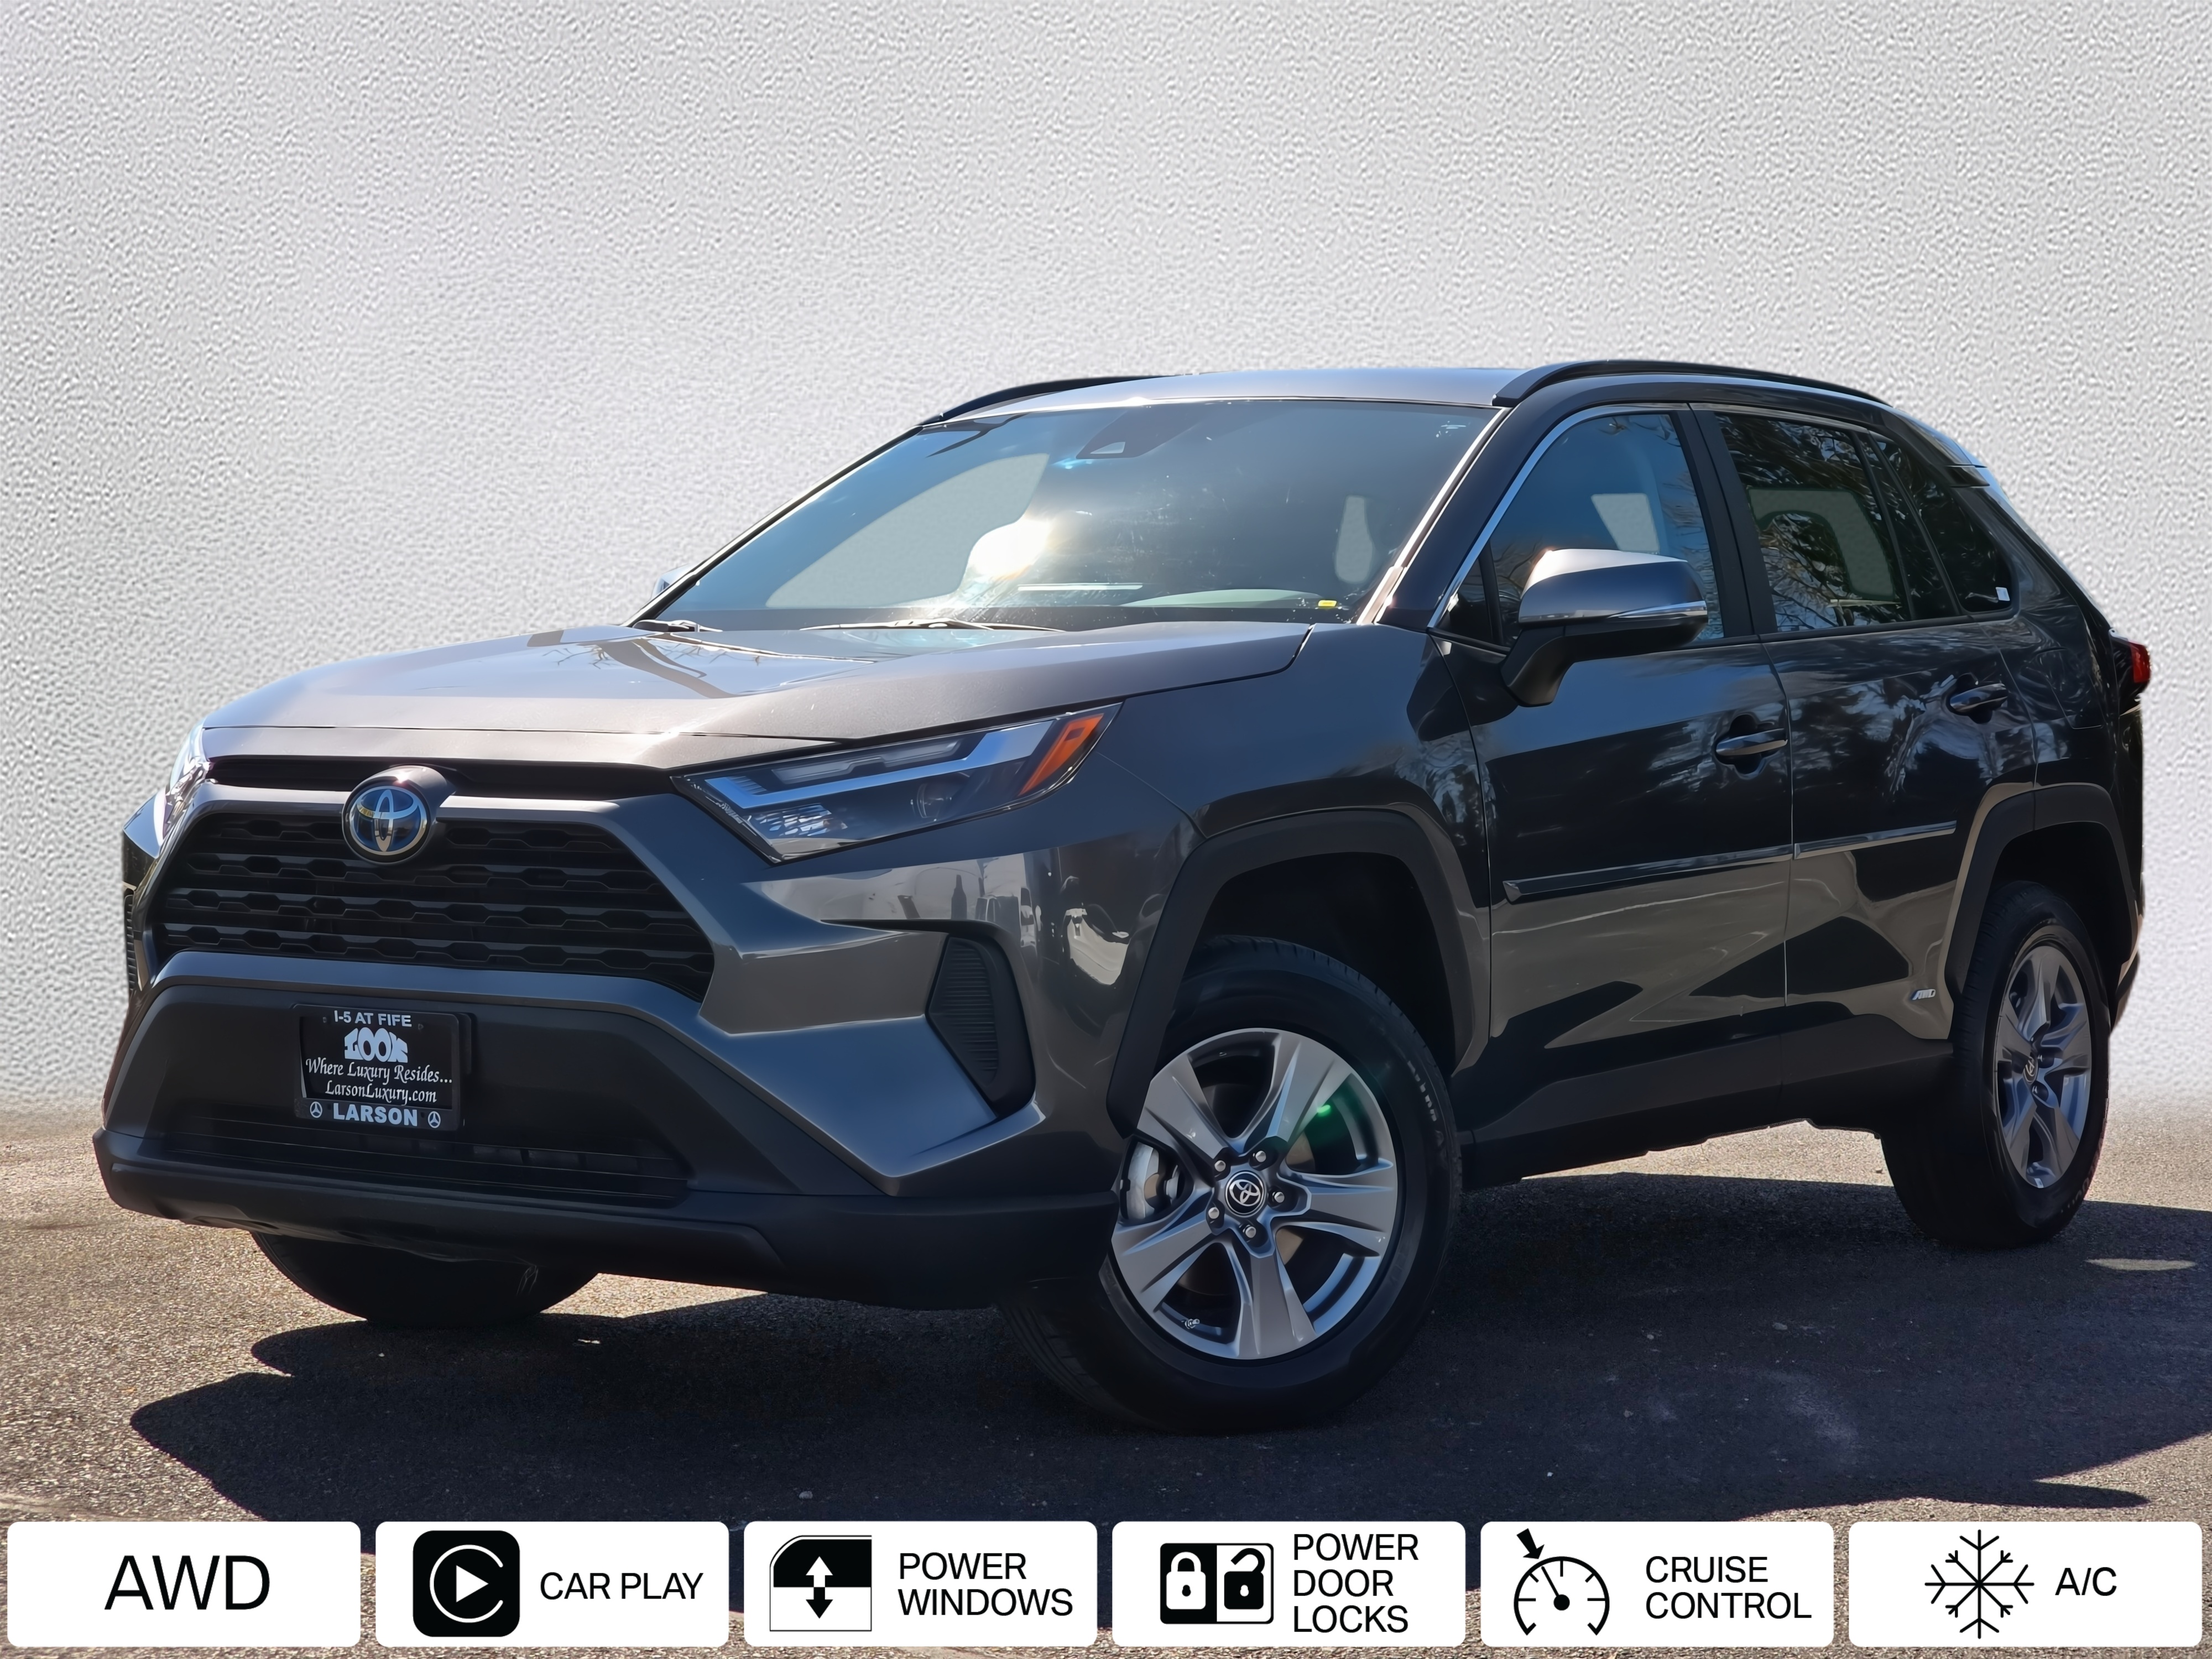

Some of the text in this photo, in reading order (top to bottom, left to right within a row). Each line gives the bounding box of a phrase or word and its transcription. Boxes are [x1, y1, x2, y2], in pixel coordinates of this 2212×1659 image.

[334, 1010, 413, 1027] I-5 AT FIFE
[344, 1027, 408, 1063] LOOK
[306, 1057, 453, 1085] Where Luxury Resides...
[325, 1080, 437, 1106] LarsonLuxury.com
[333, 1103, 418, 1126] LARSON
